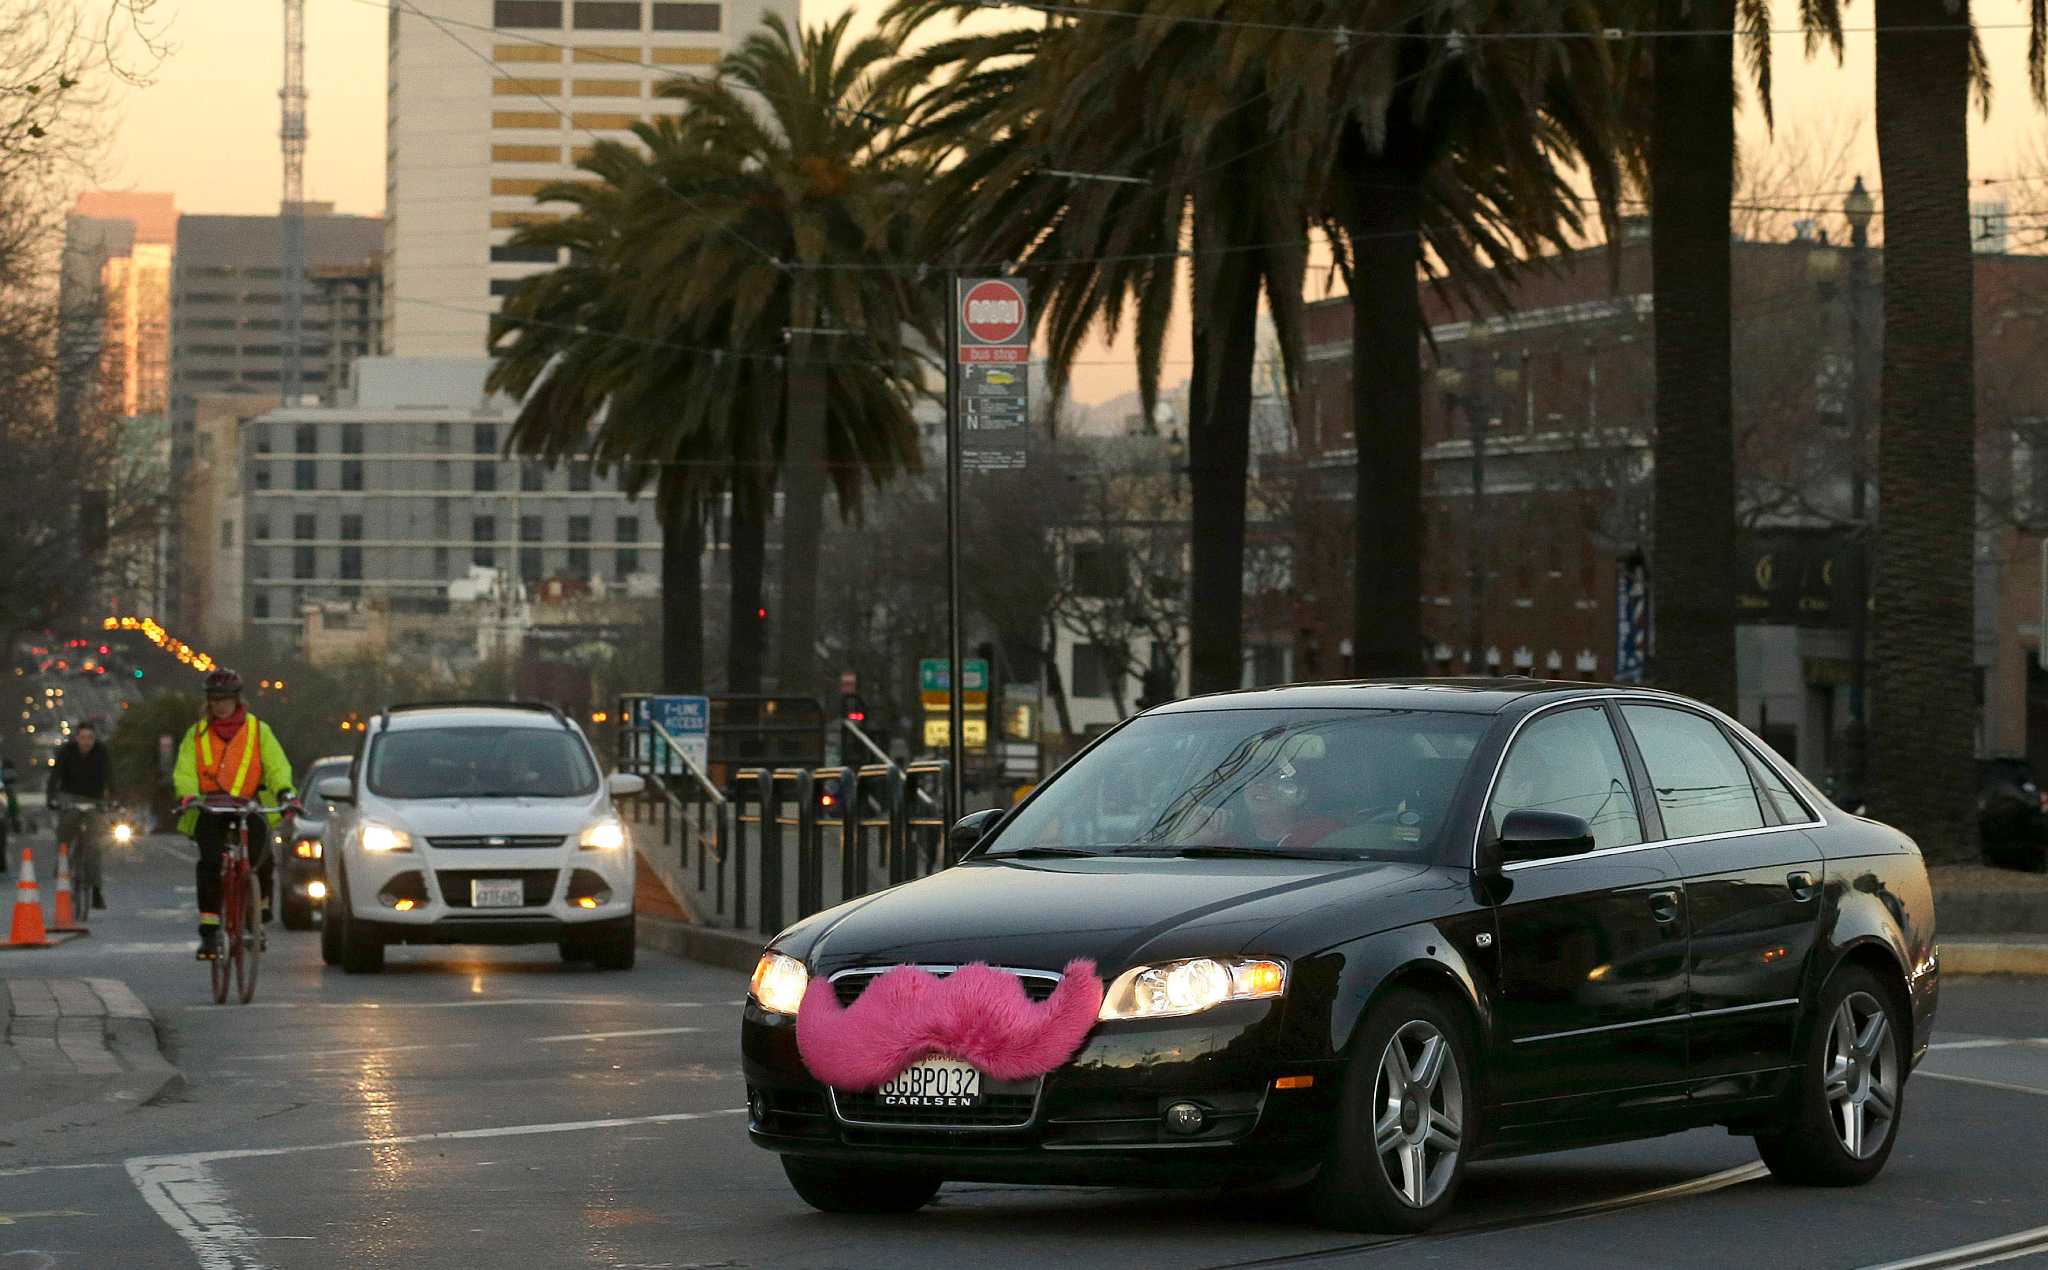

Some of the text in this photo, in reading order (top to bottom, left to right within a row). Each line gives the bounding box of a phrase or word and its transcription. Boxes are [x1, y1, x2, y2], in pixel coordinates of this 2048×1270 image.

[970, 348, 1018, 361] bus stop
[966, 364, 974, 379] F
[968, 399, 976, 413] L
[967, 416, 978, 430] N
[664, 703, 699, 715] F-LINE
[664, 716, 704, 729] ACCESS
[885, 1096, 971, 1106] CARLSEN
